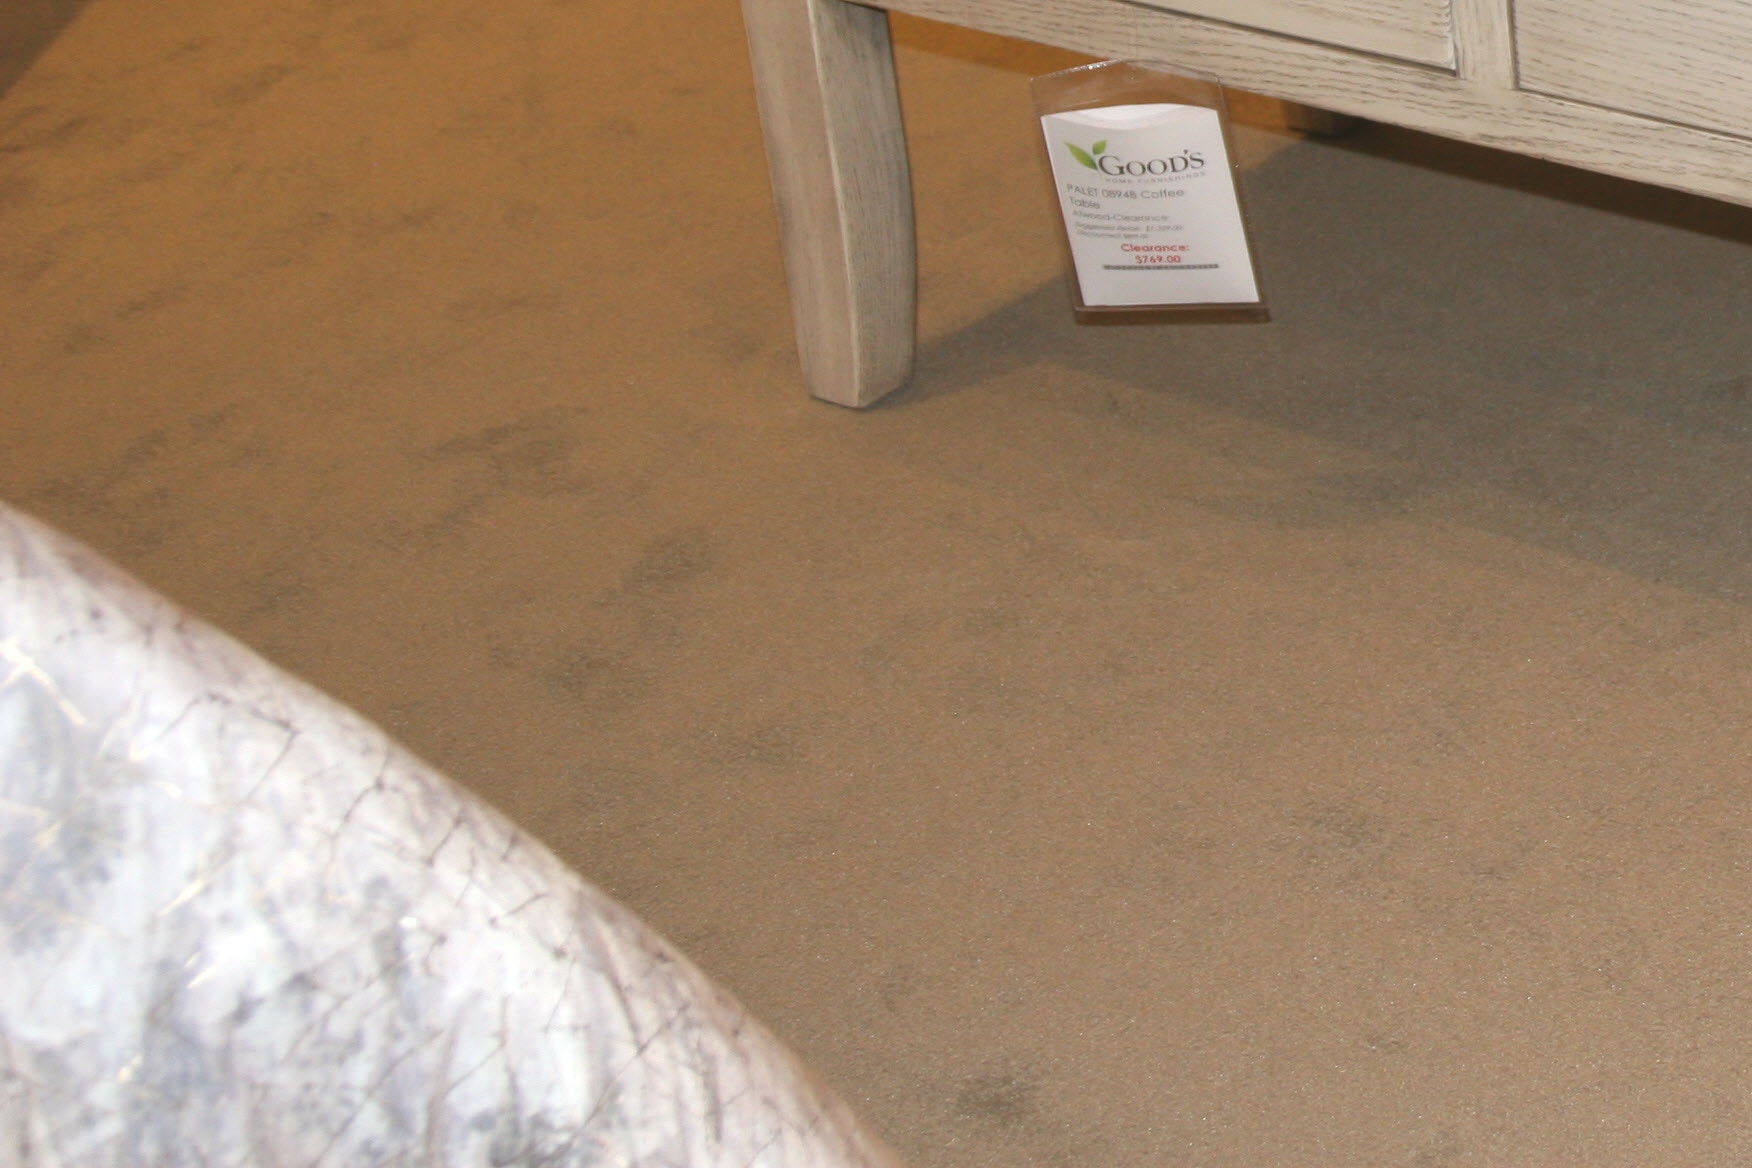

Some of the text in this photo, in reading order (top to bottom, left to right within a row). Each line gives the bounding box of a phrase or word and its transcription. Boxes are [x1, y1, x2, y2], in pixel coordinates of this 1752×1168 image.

[1098, 149, 1204, 176] GOOD'S
[1140, 188, 1184, 199] Coffee
[1121, 243, 1190, 252] Clearance:
[1135, 255, 1181, 264] $769.00
